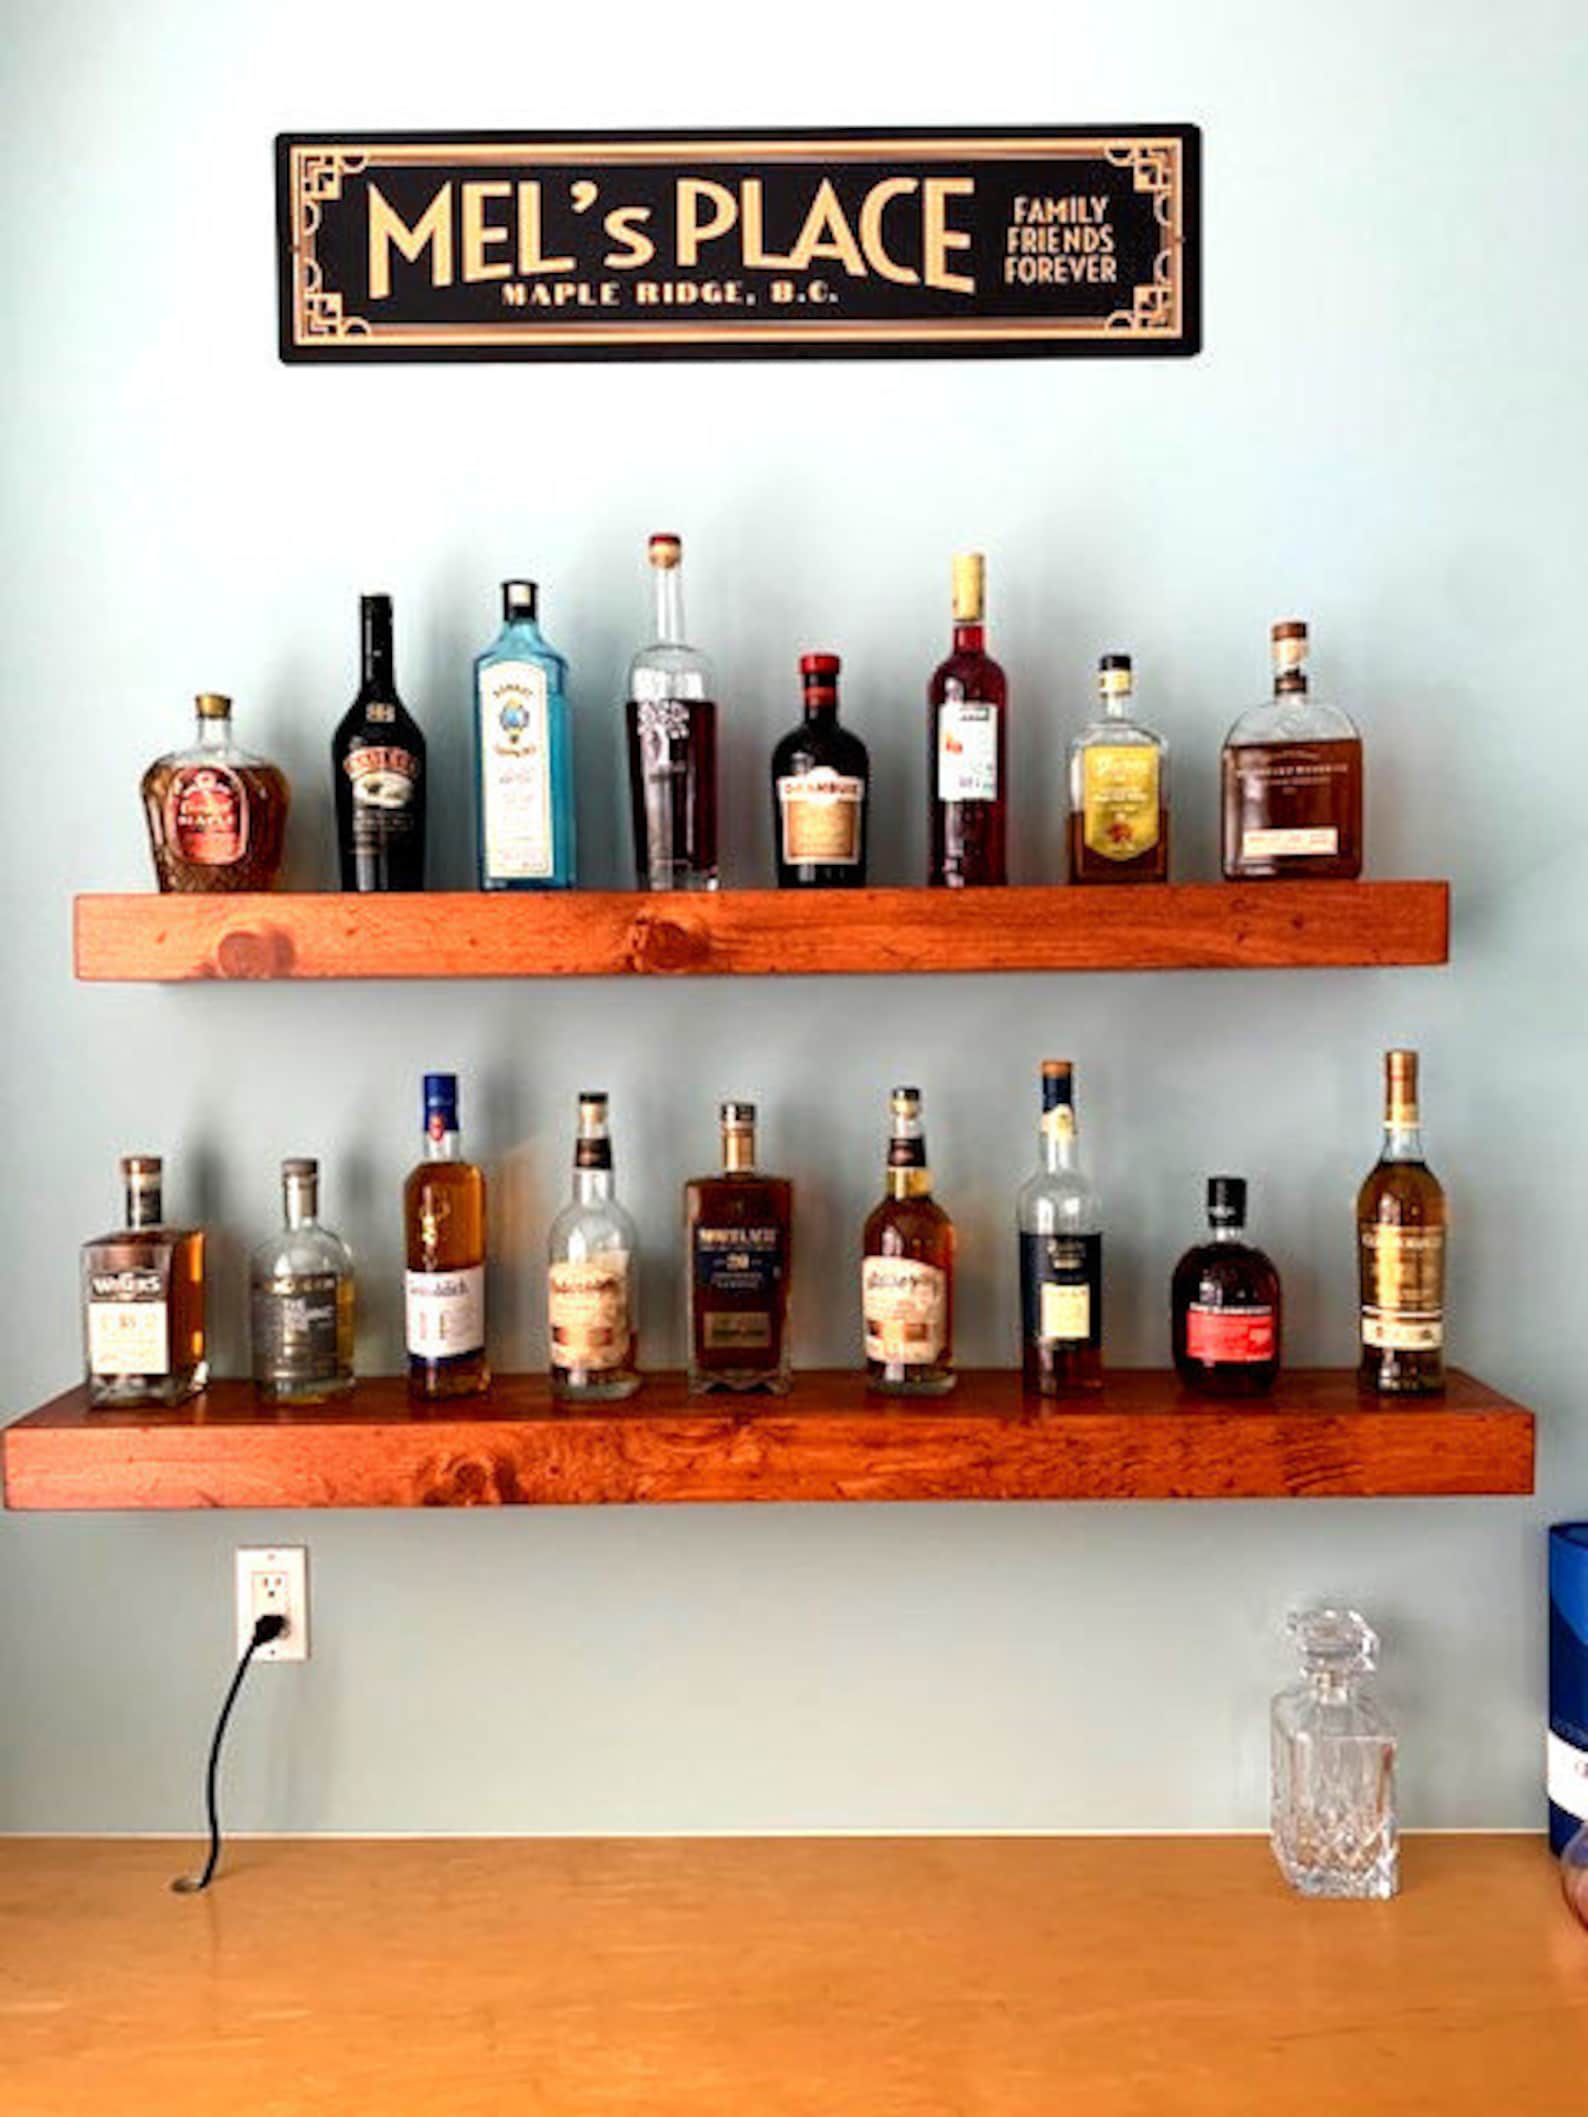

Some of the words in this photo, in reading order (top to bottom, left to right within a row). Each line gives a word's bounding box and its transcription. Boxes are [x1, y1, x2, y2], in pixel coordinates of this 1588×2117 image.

[1012, 195, 1111, 225] FAMILY
[675, 176, 976, 295] PLACE
[1006, 225, 1117, 255] FRIENDS
[1003, 255, 1118, 285] FOREVER
[502, 282, 622, 306] MAPLE
[636, 280, 756, 306] RIDGE,
[770, 279, 840, 304] B.C.
